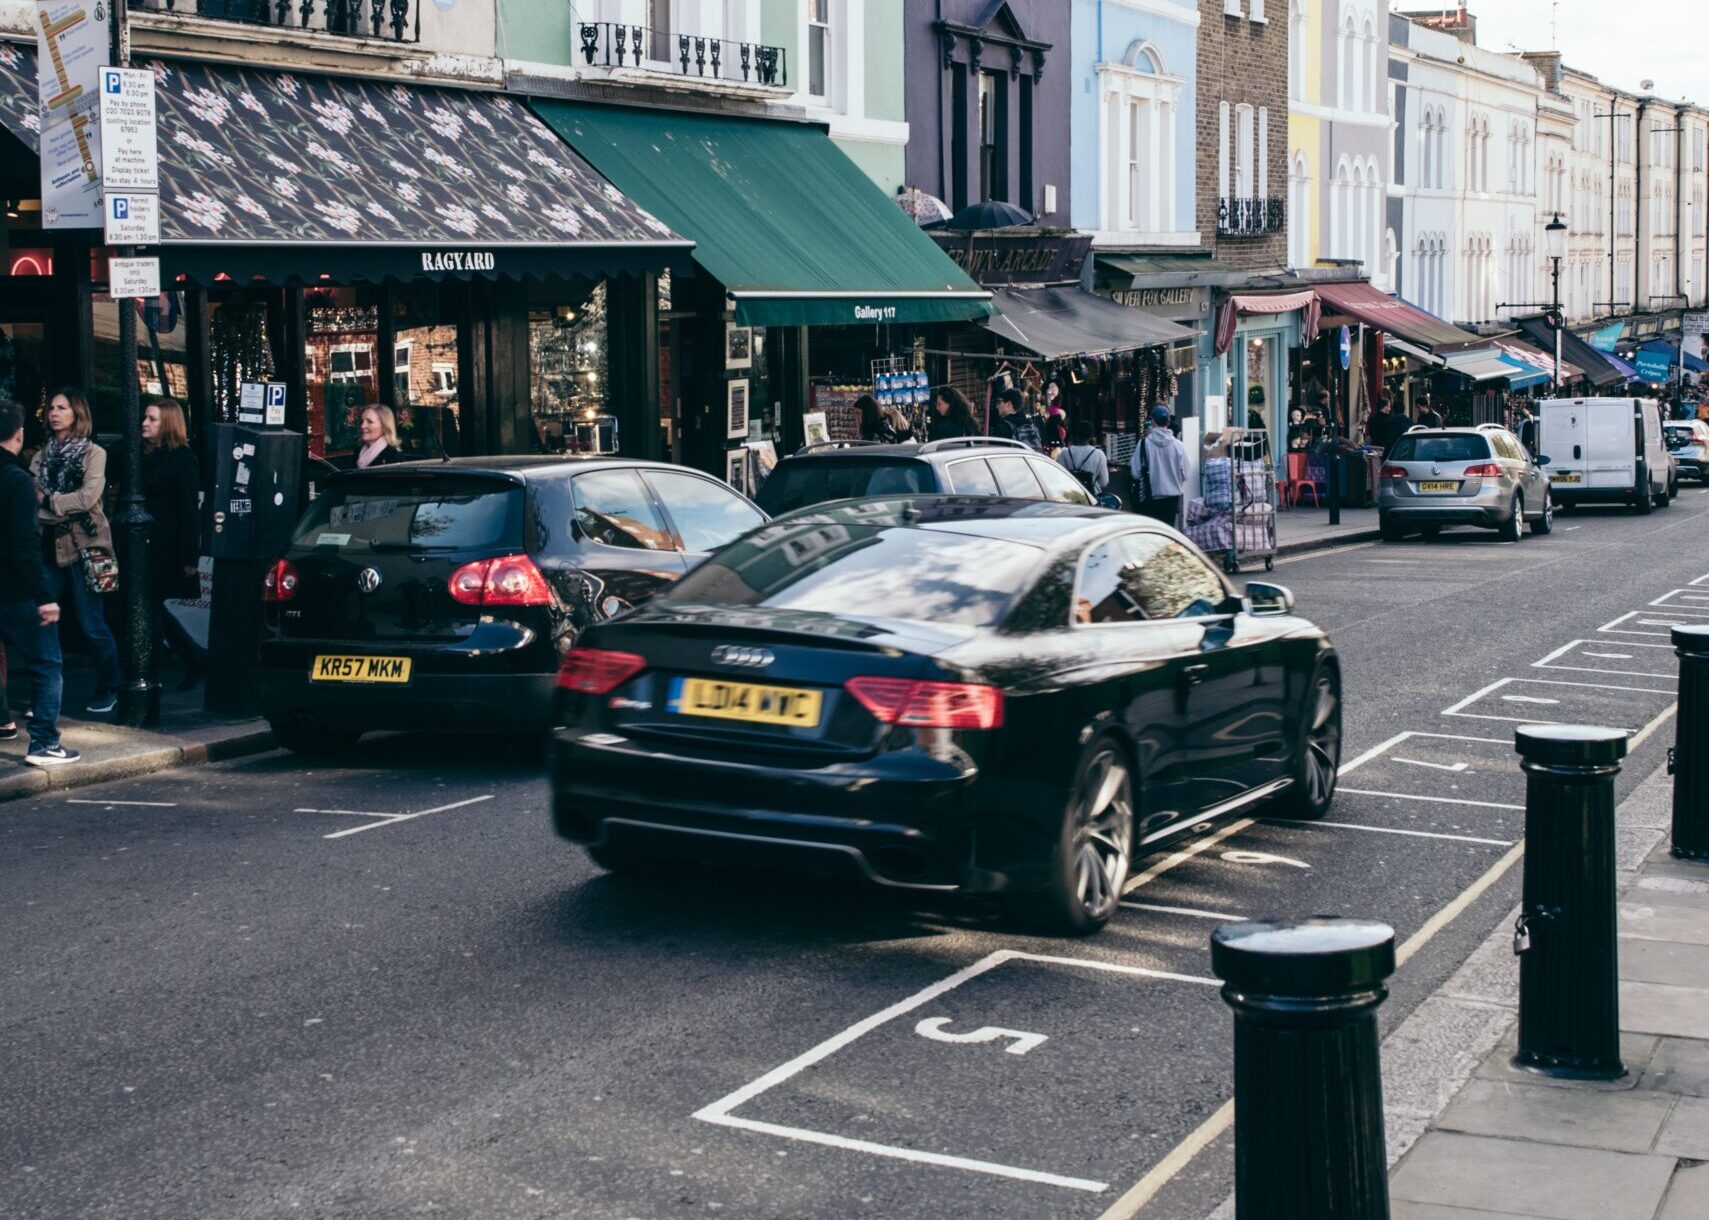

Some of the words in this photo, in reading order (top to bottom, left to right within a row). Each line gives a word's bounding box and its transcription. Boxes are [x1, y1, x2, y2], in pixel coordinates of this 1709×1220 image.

[129, 118, 152, 126] location
[118, 147, 128, 156] Pay
[112, 166, 132, 175] Display
[131, 196, 149, 204] Permit
[120, 224, 145, 232] Saturday
[136, 260, 155, 268] traders
[421, 251, 495, 271] RAGYARD
[999, 248, 1059, 272] ARCADE
[124, 277, 147, 285] Saturday
[1112, 289, 1140, 307] SILVER
[1142, 288, 1159, 306] FOX
[1160, 288, 1194, 305] GALLERY
[854, 305, 883, 322] Gallery
[883, 306, 897, 318] 117
[319, 657, 366, 677] KR57
[367, 658, 404, 679] MKM
[914, 1016, 1050, 1055] 5
